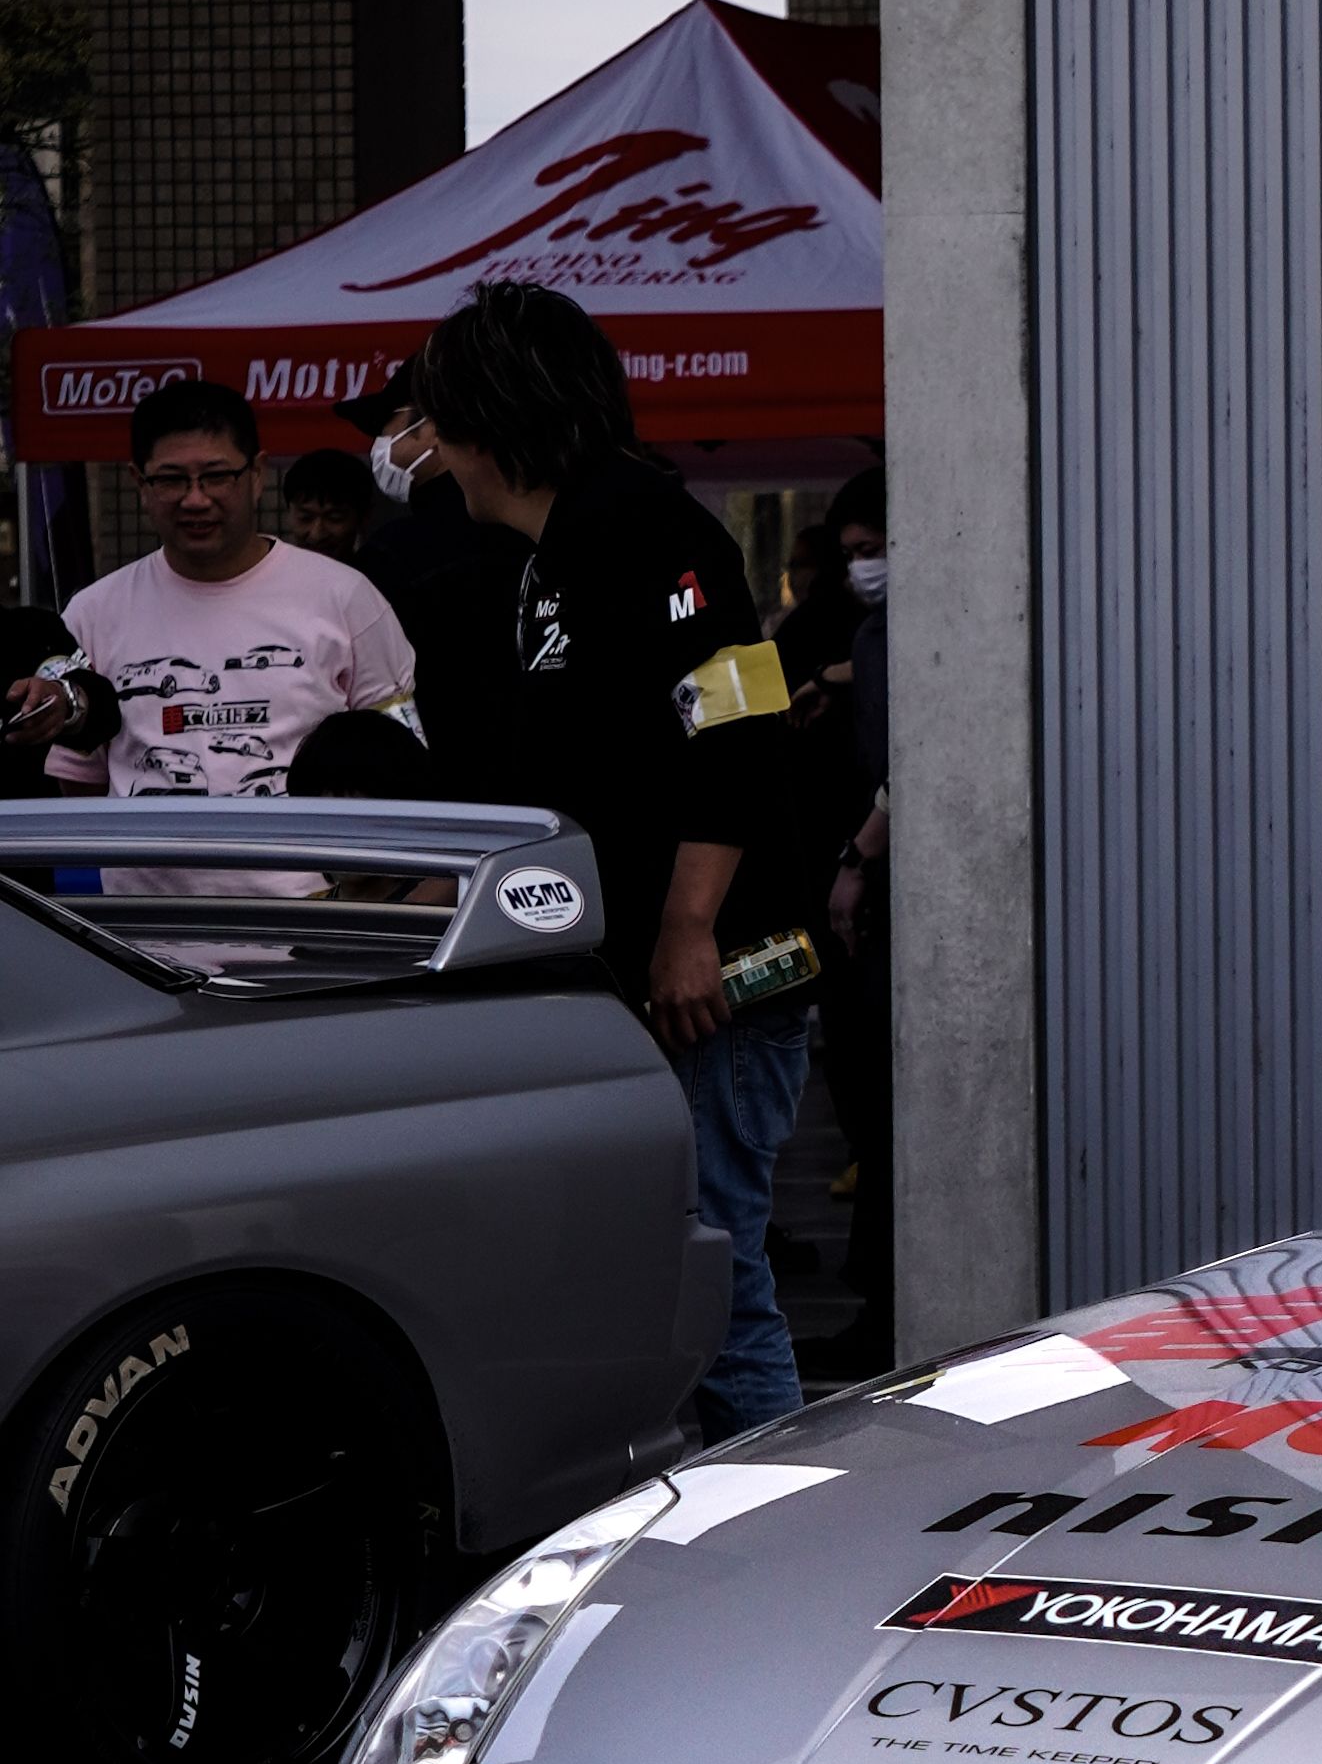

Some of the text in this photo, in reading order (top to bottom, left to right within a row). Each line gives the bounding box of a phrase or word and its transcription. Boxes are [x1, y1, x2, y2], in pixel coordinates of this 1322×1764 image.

[504, 881, 574, 910] NISMO
[48, 1323, 191, 1516] ADVAN
[866, 1679, 1243, 1744] CVSTOS
[870, 1737, 932, 1752] THE
[943, 1741, 1014, 1759] TIME
